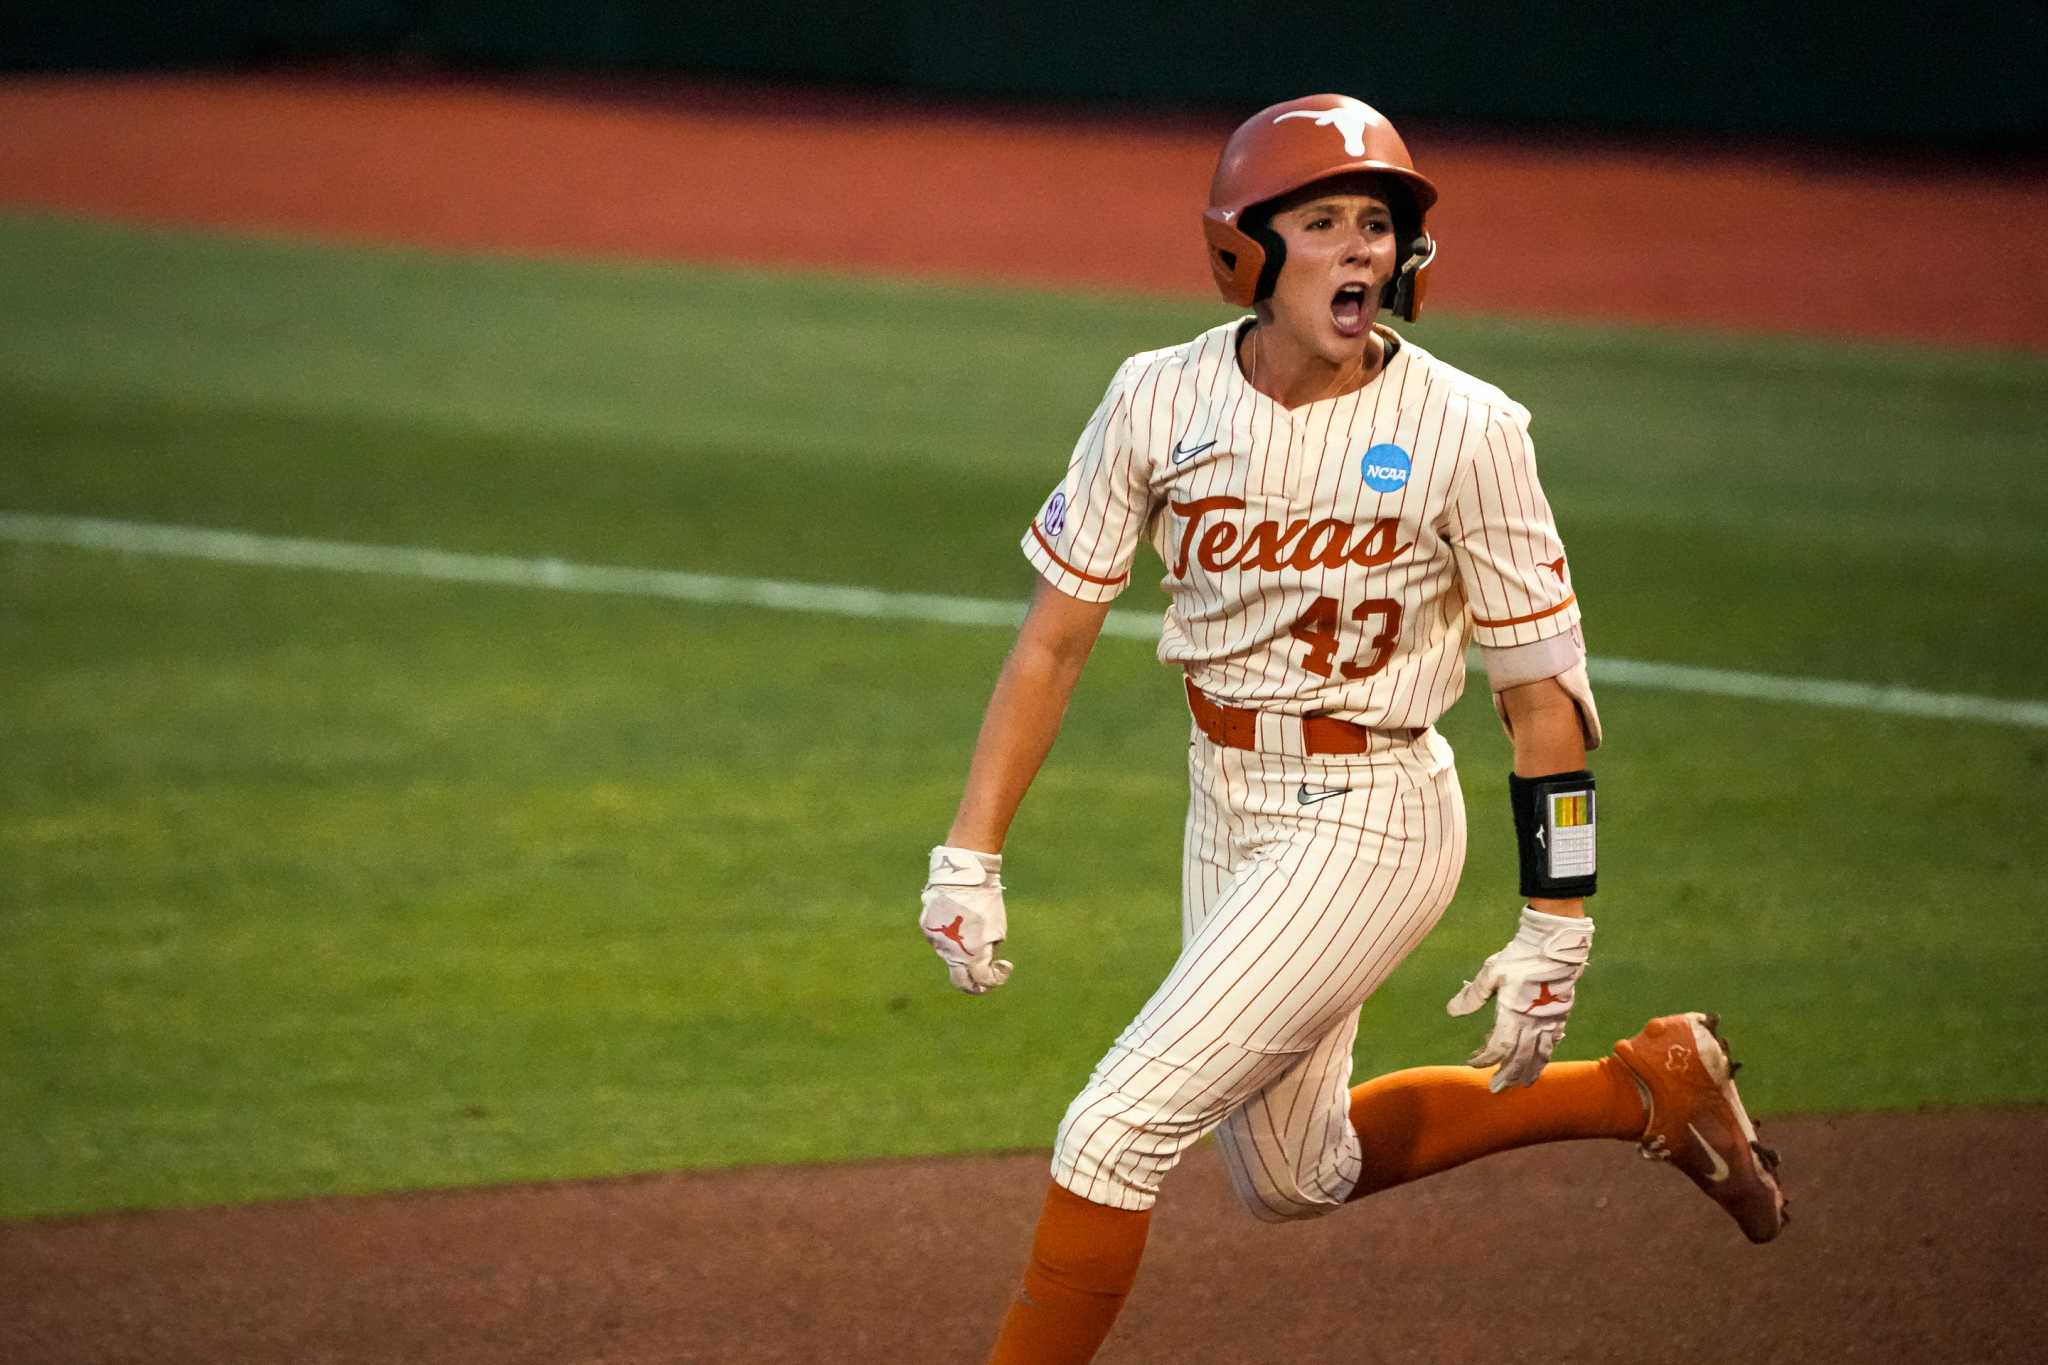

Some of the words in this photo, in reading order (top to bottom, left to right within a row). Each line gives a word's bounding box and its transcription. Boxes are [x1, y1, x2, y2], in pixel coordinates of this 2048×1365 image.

[1367, 464, 1406, 482] NCAA
[1171, 497, 1413, 580] Texas
[1290, 597, 1403, 679] 43
